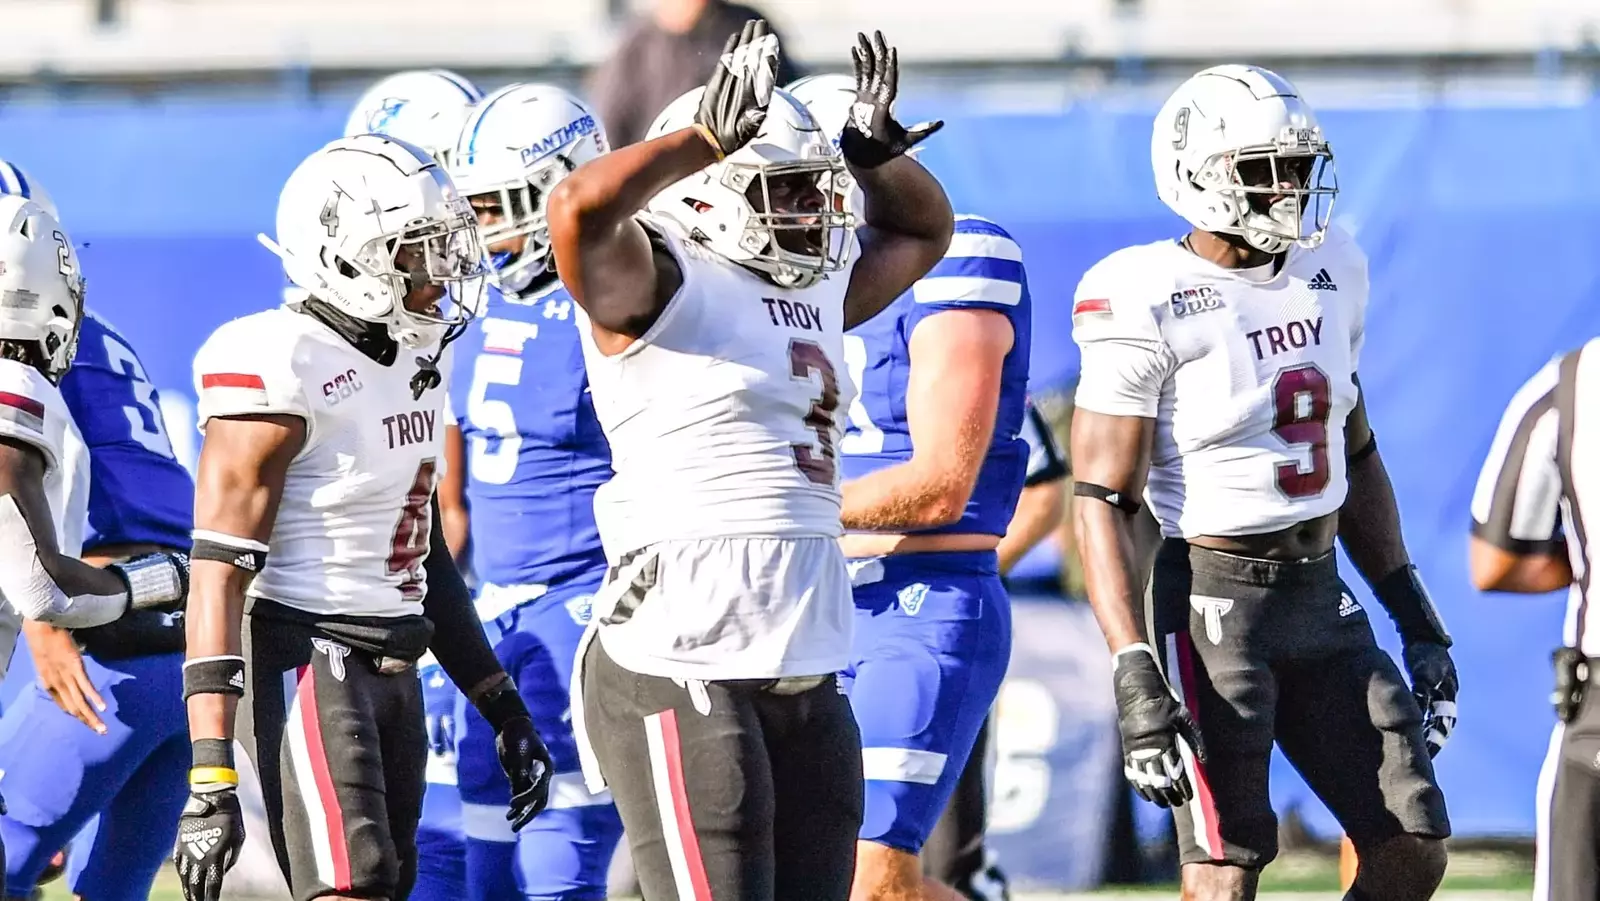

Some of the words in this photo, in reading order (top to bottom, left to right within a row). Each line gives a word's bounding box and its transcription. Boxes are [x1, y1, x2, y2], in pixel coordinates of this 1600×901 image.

[520, 114, 595, 164] PANTHERS
[1172, 107, 1191, 150] 9
[319, 190, 341, 238] 4
[53, 230, 76, 277] 2
[761, 297, 824, 332] TROY
[1246, 316, 1324, 360] TROY
[382, 409, 436, 449] TROY
[467, 353, 525, 485] 5
[787, 336, 840, 490] 3
[1269, 361, 1332, 502] 9
[384, 456, 437, 602] 4
